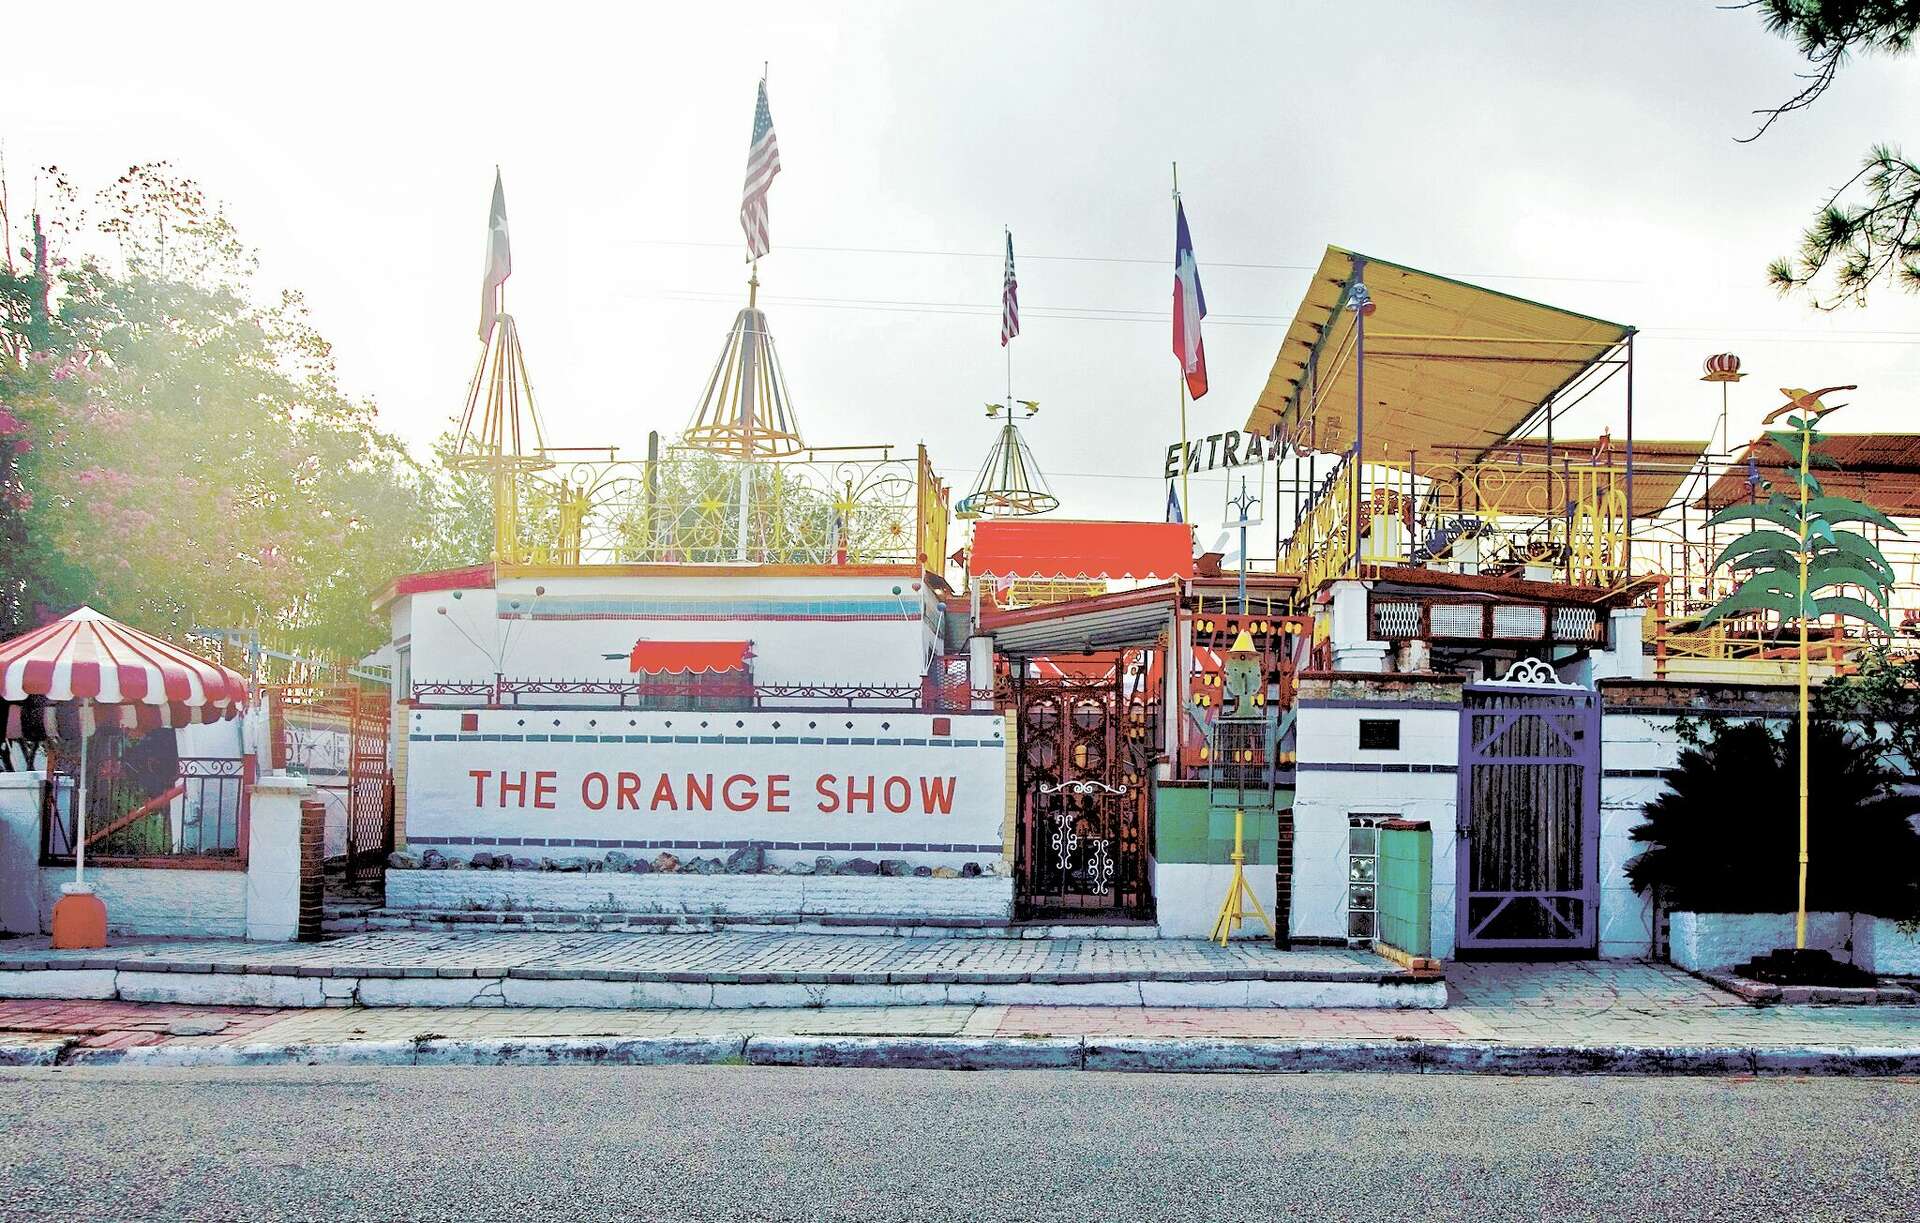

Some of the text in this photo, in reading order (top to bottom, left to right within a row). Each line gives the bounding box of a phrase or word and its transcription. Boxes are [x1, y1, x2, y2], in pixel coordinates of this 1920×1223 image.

[469, 770, 957, 815] THE ORANGE SHOW
